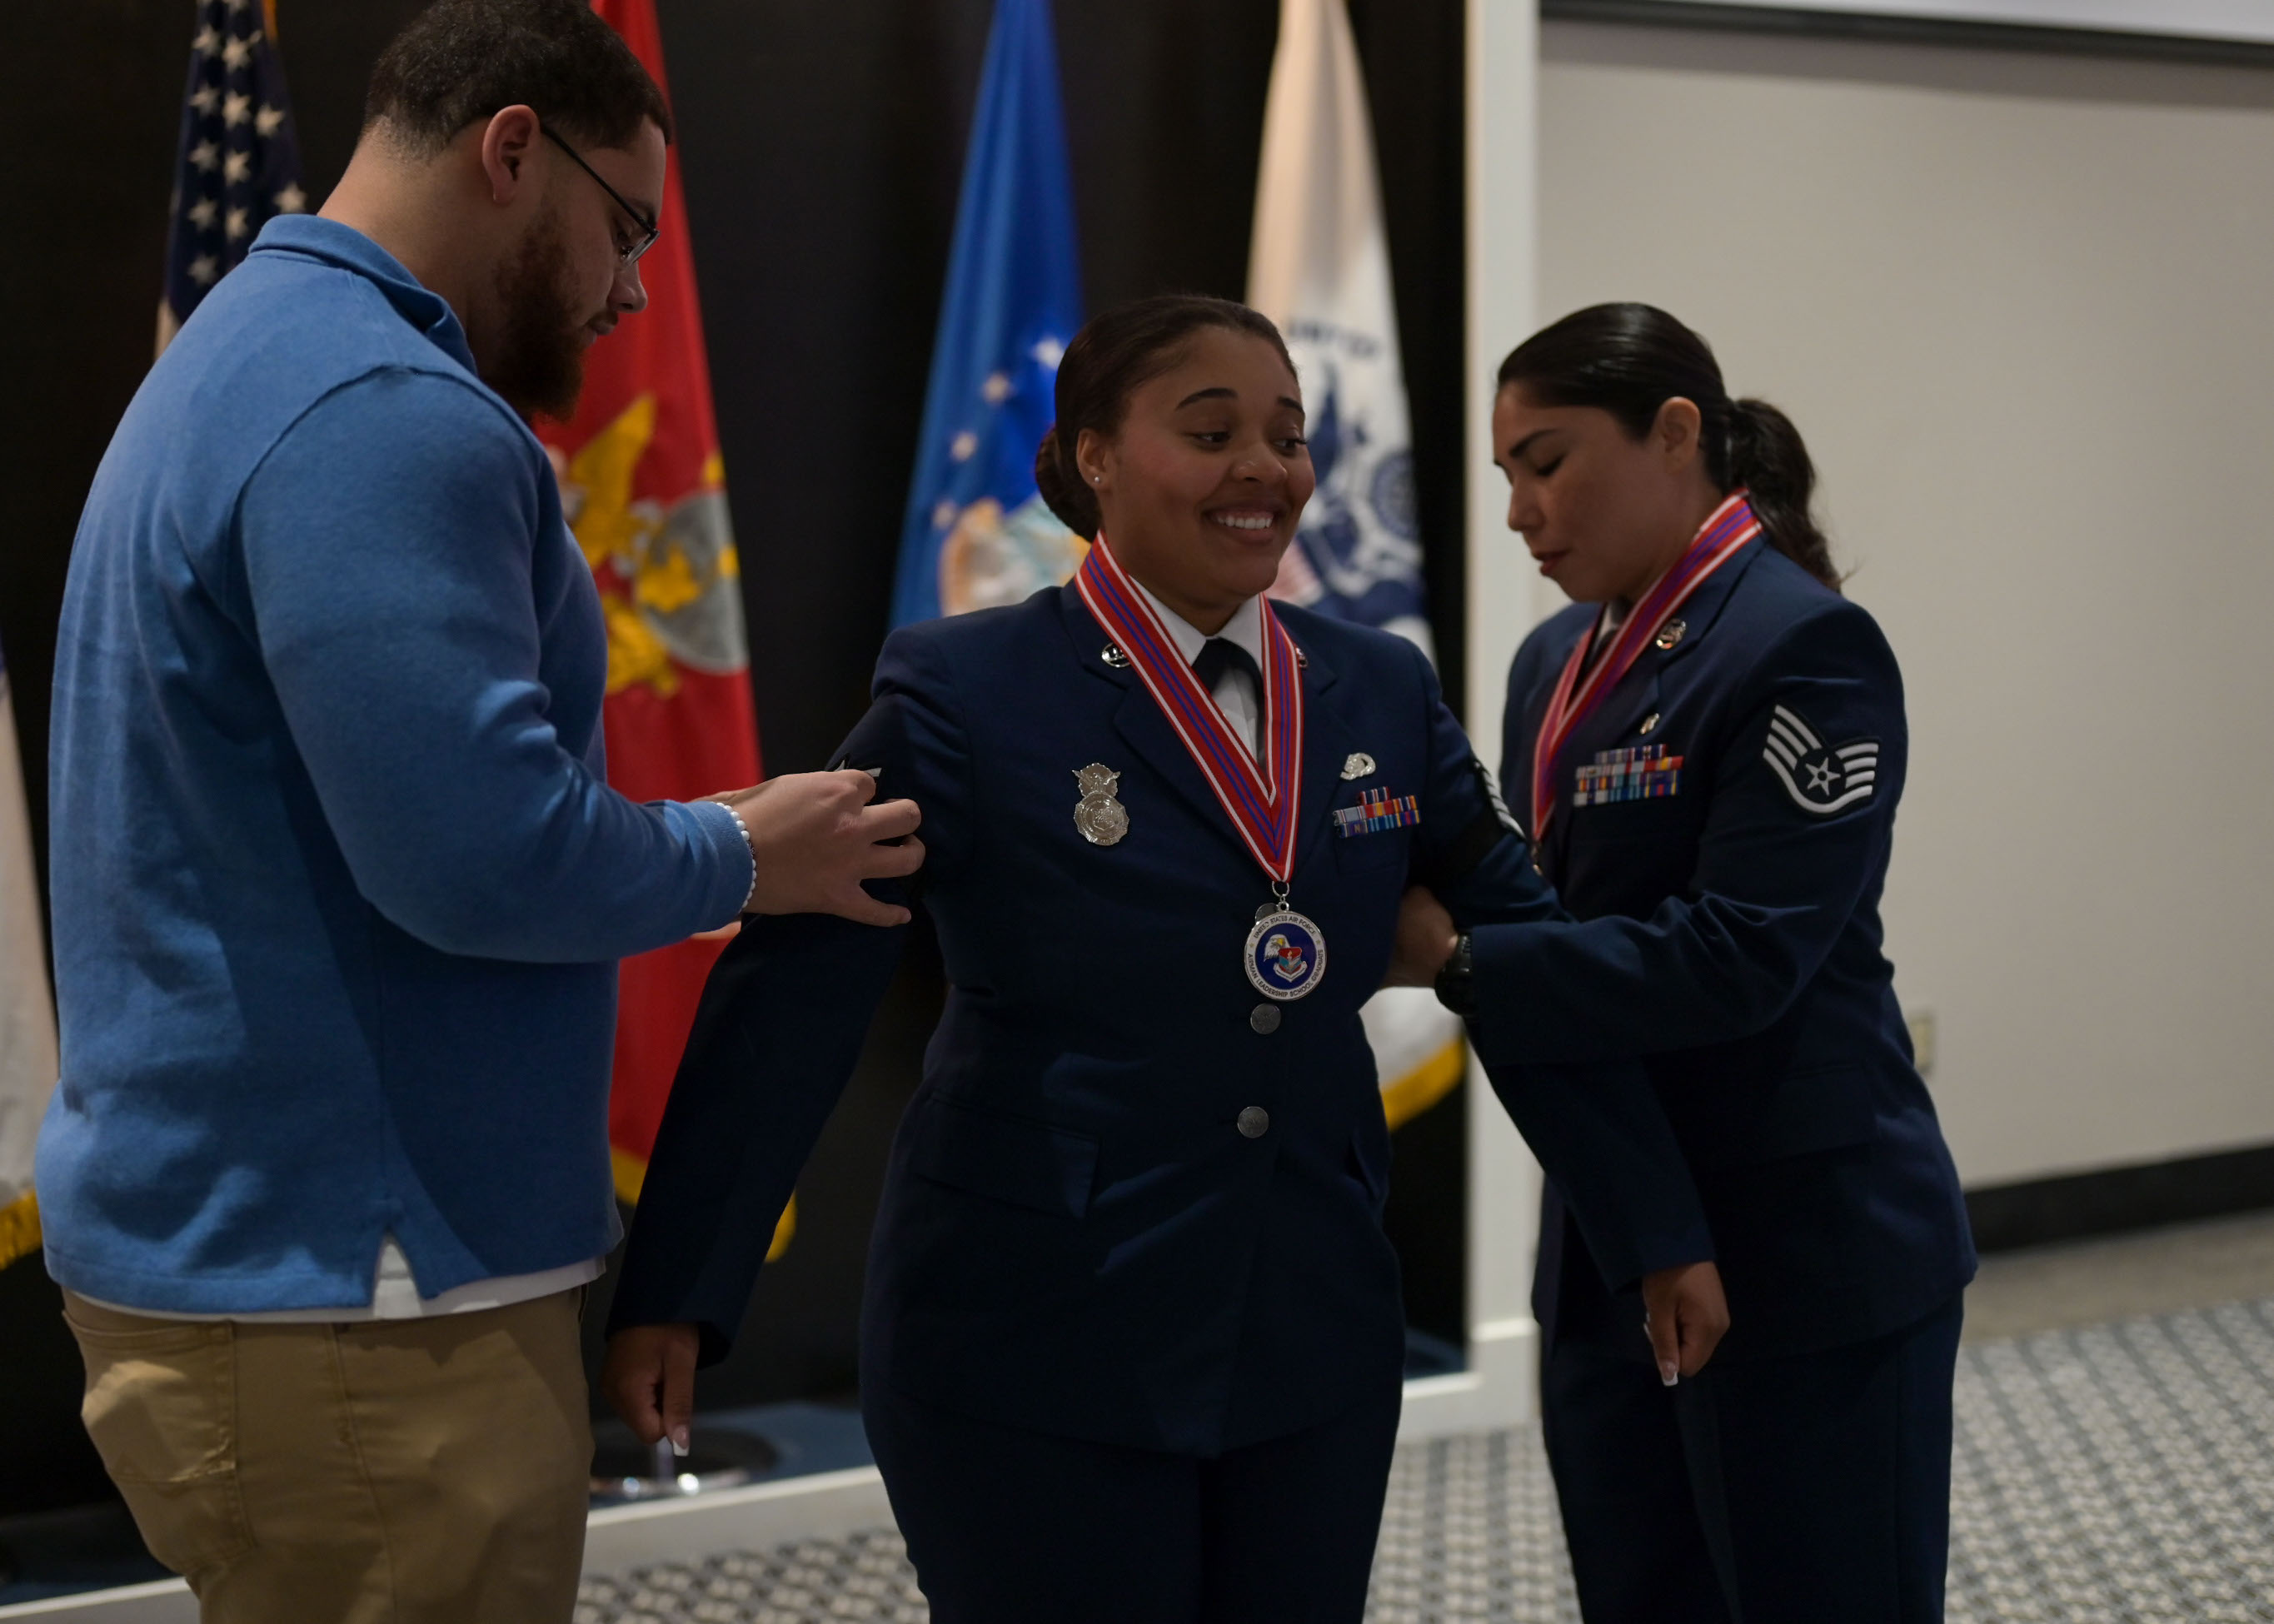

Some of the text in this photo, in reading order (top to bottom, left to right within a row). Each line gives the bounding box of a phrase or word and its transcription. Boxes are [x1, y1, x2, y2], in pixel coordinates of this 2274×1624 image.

[1254, 921, 1269, 938] UNITED
[1299, 919, 1316, 934] FORCE
[1248, 953, 1259, 979] AIRMAN
[1256, 979, 1288, 997] LEADERSHIP
[1290, 982, 1313, 997] SCHOOL
